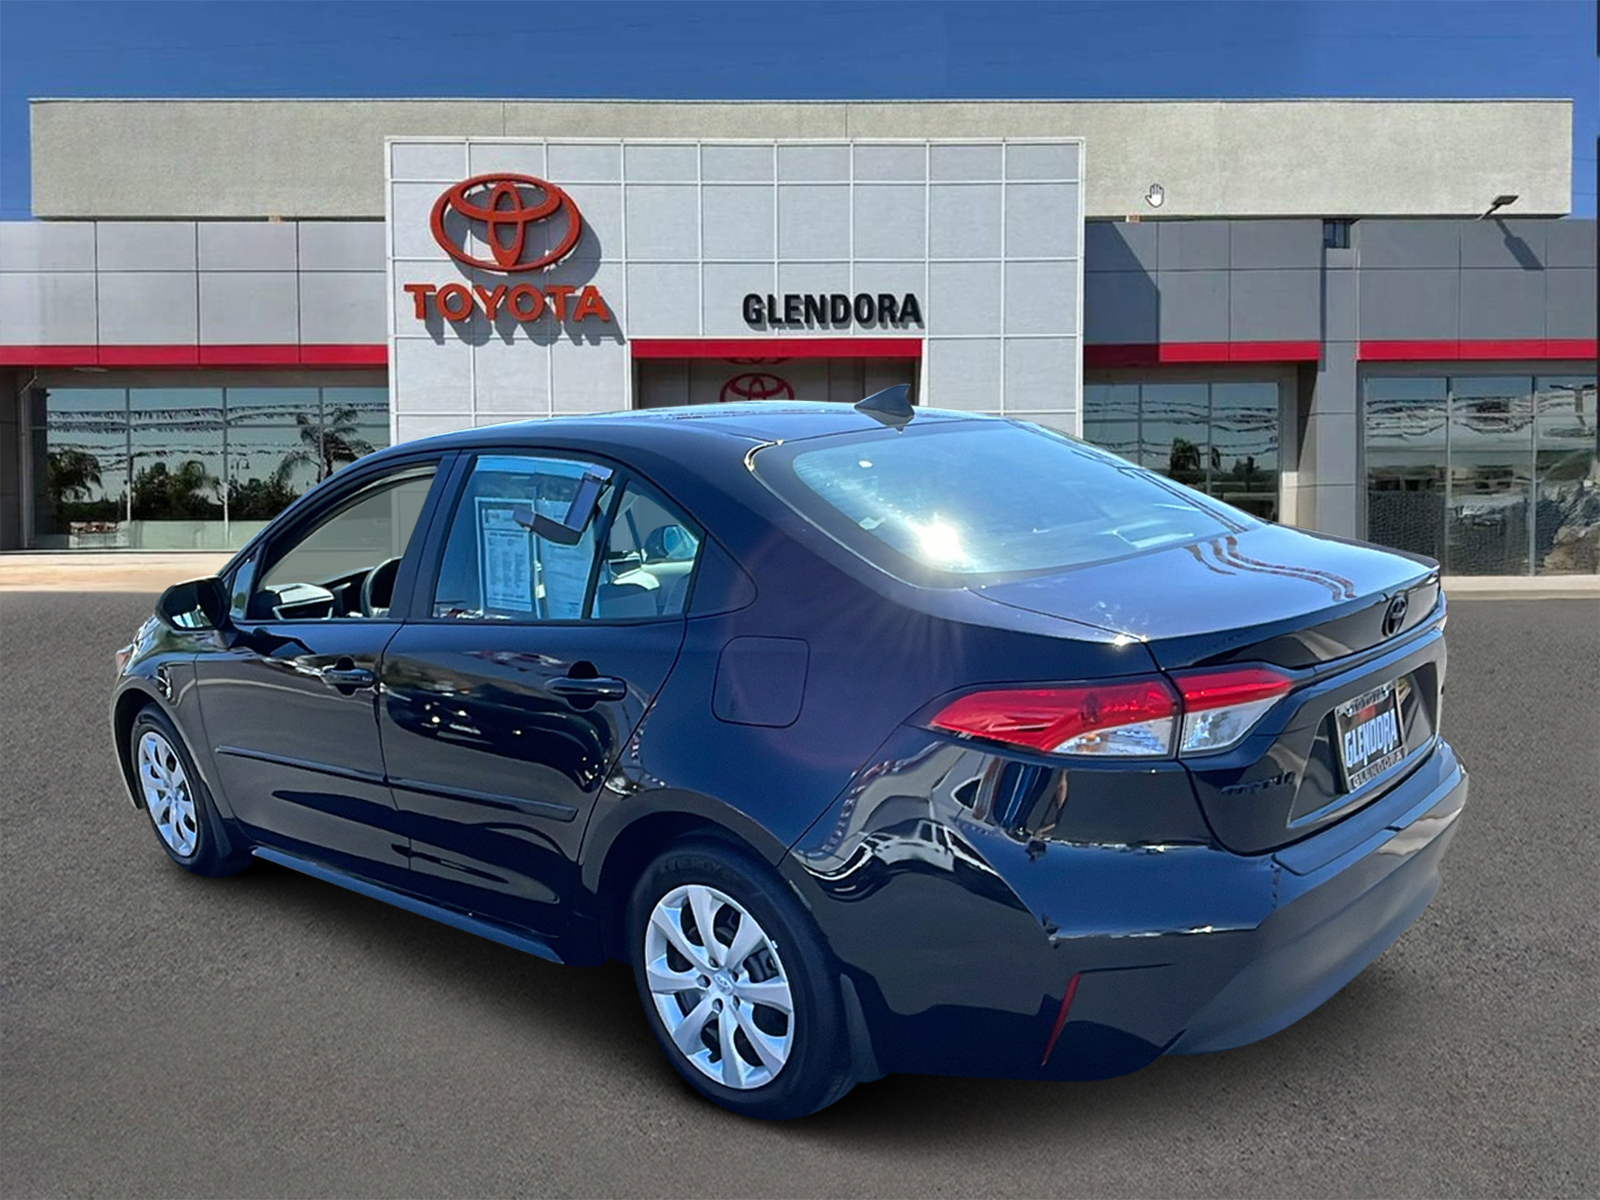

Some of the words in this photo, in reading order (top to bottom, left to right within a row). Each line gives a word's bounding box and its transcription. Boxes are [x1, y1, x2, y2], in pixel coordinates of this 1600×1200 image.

[404, 283, 610, 322] TOYOTA
[742, 293, 923, 324] GLENDORA
[1344, 708, 1398, 768] GLENDORA
[1352, 752, 1404, 787] GLENDORA
